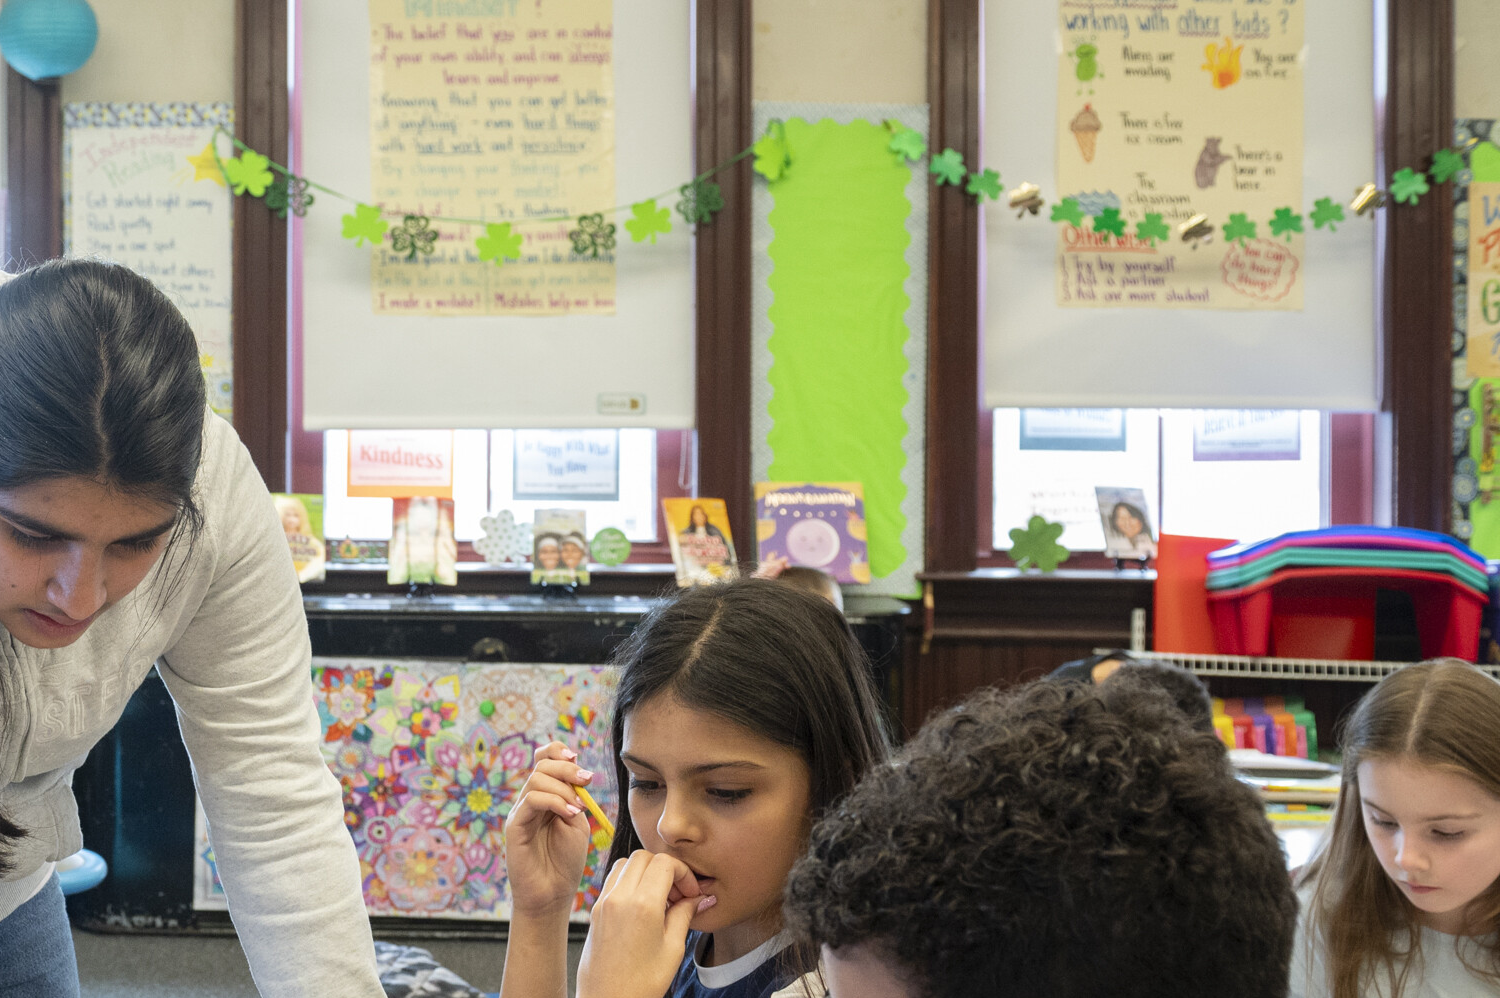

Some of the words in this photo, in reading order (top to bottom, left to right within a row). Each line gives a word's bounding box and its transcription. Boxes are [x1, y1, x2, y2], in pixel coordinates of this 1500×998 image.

[1062, 9, 1130, 39] working
[1136, 8, 1170, 31] with
[1178, 8, 1220, 31] other
[360, 444, 444, 470] Kindness
